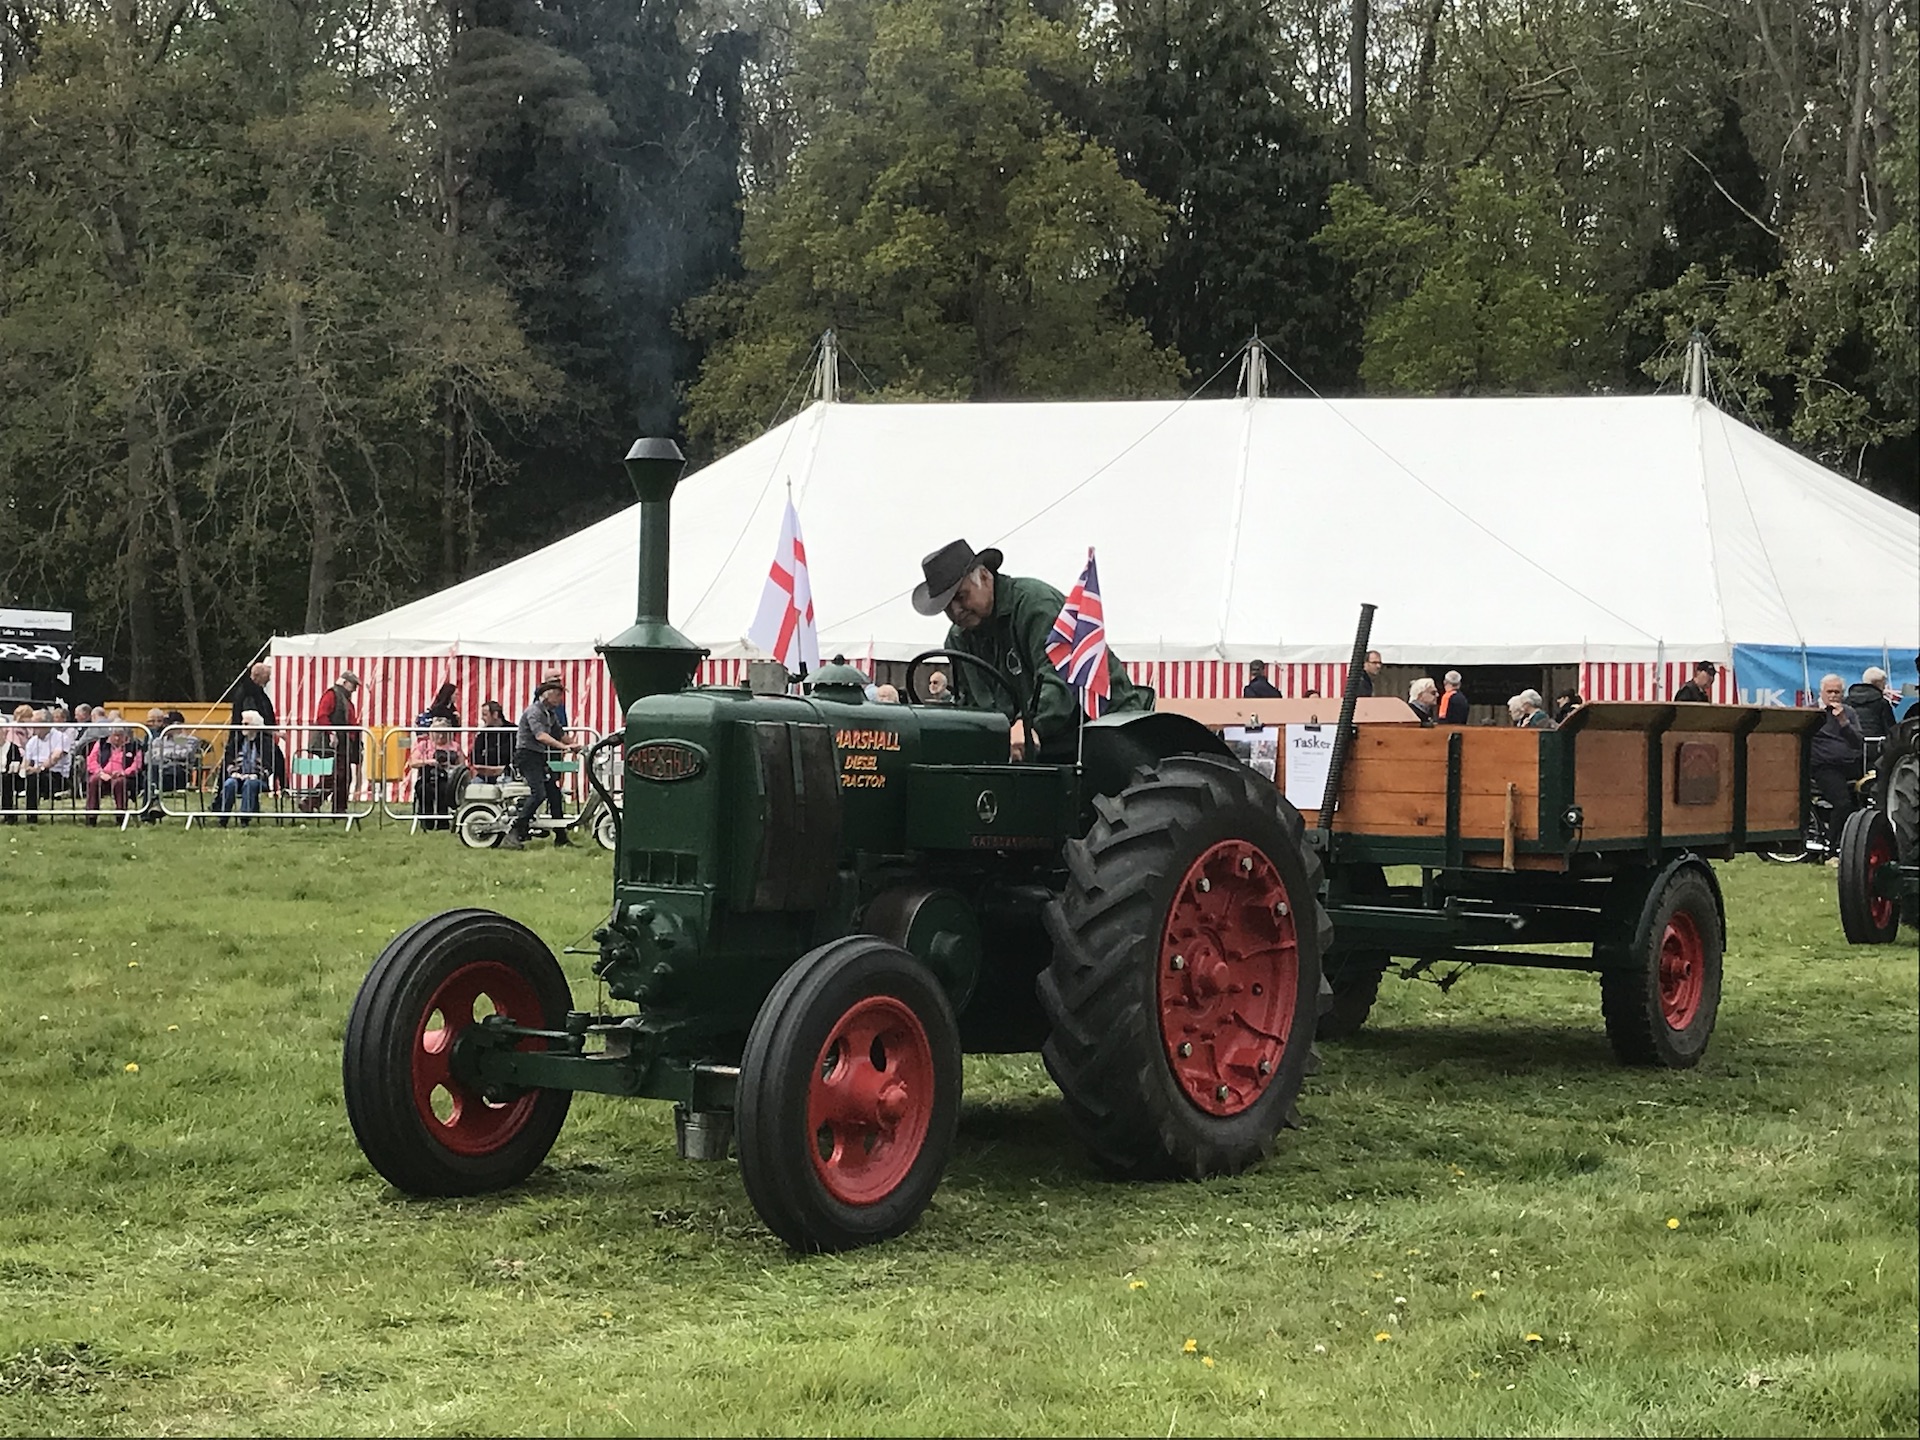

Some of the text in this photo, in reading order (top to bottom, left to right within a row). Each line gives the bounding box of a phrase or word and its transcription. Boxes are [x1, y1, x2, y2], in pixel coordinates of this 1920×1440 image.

[1293, 735, 1332, 749] Tasker
[844, 755, 878, 770] DIESEL
[840, 774, 886, 788] RACTOR
